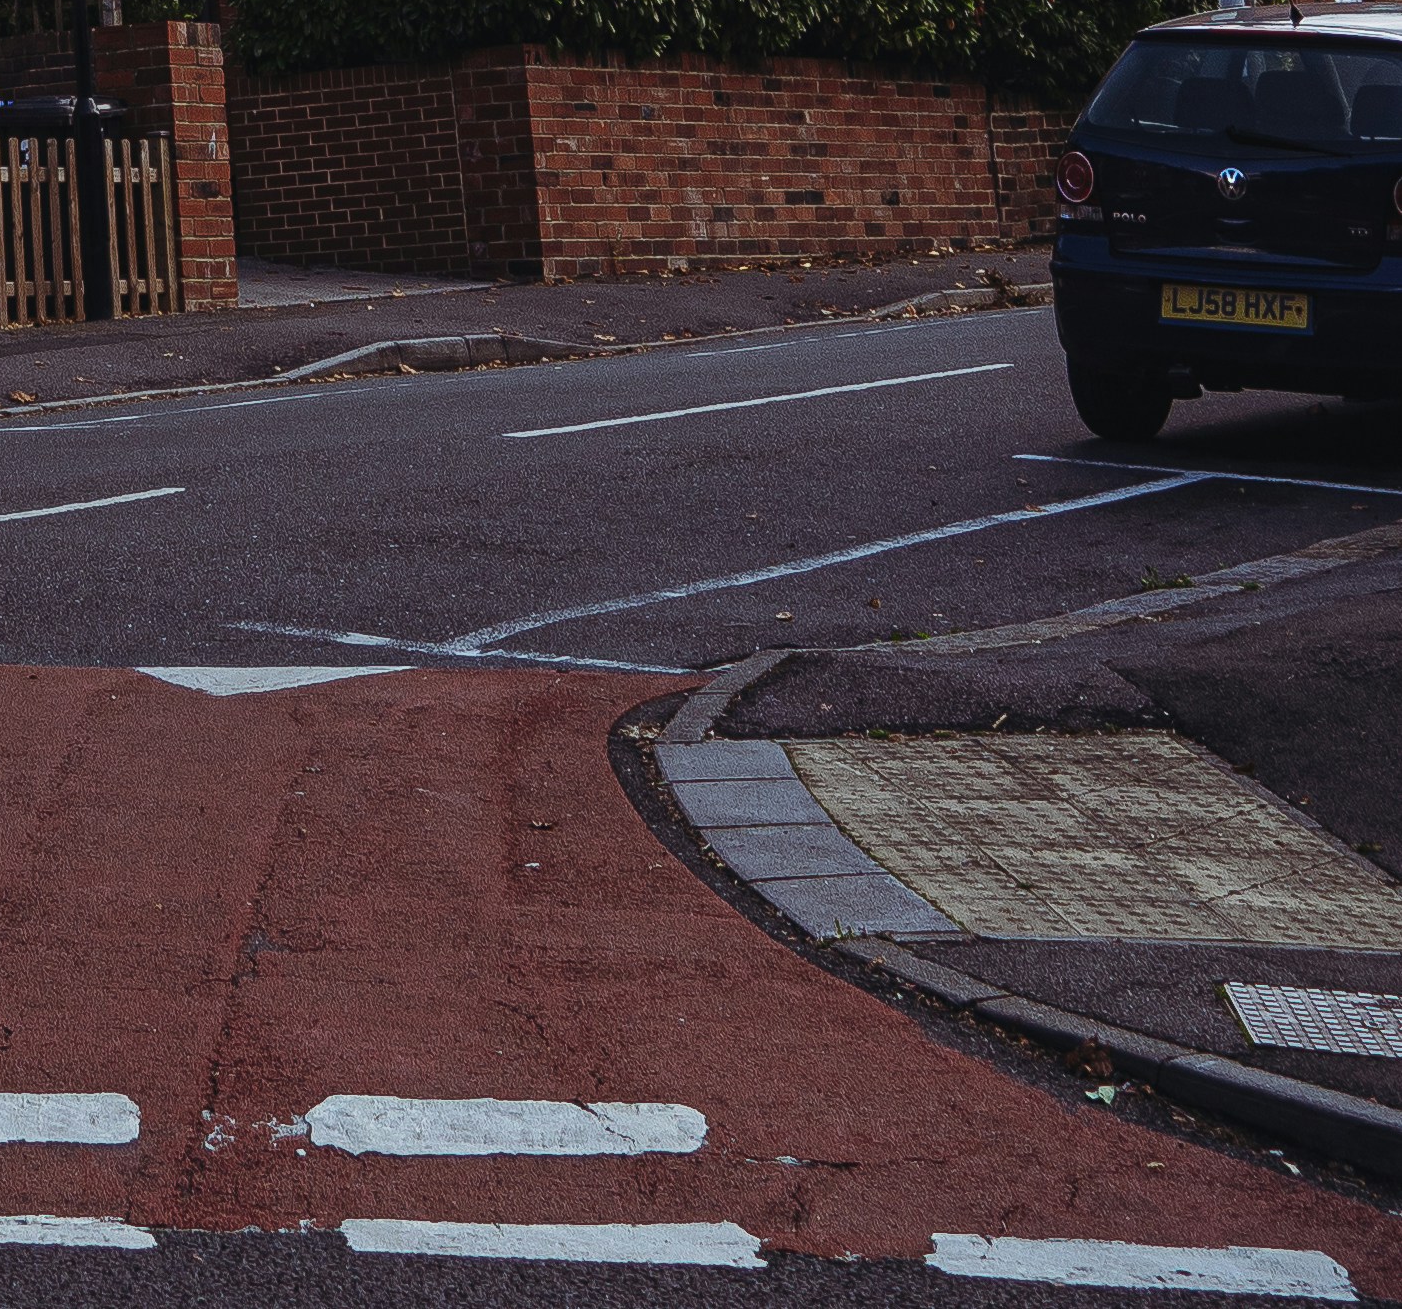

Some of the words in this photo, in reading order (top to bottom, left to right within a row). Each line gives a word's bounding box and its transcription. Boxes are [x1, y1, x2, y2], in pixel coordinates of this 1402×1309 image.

[1112, 212, 1147, 223] POLO
[1171, 287, 1238, 317] LJ58
[1244, 293, 1296, 321] HXF
